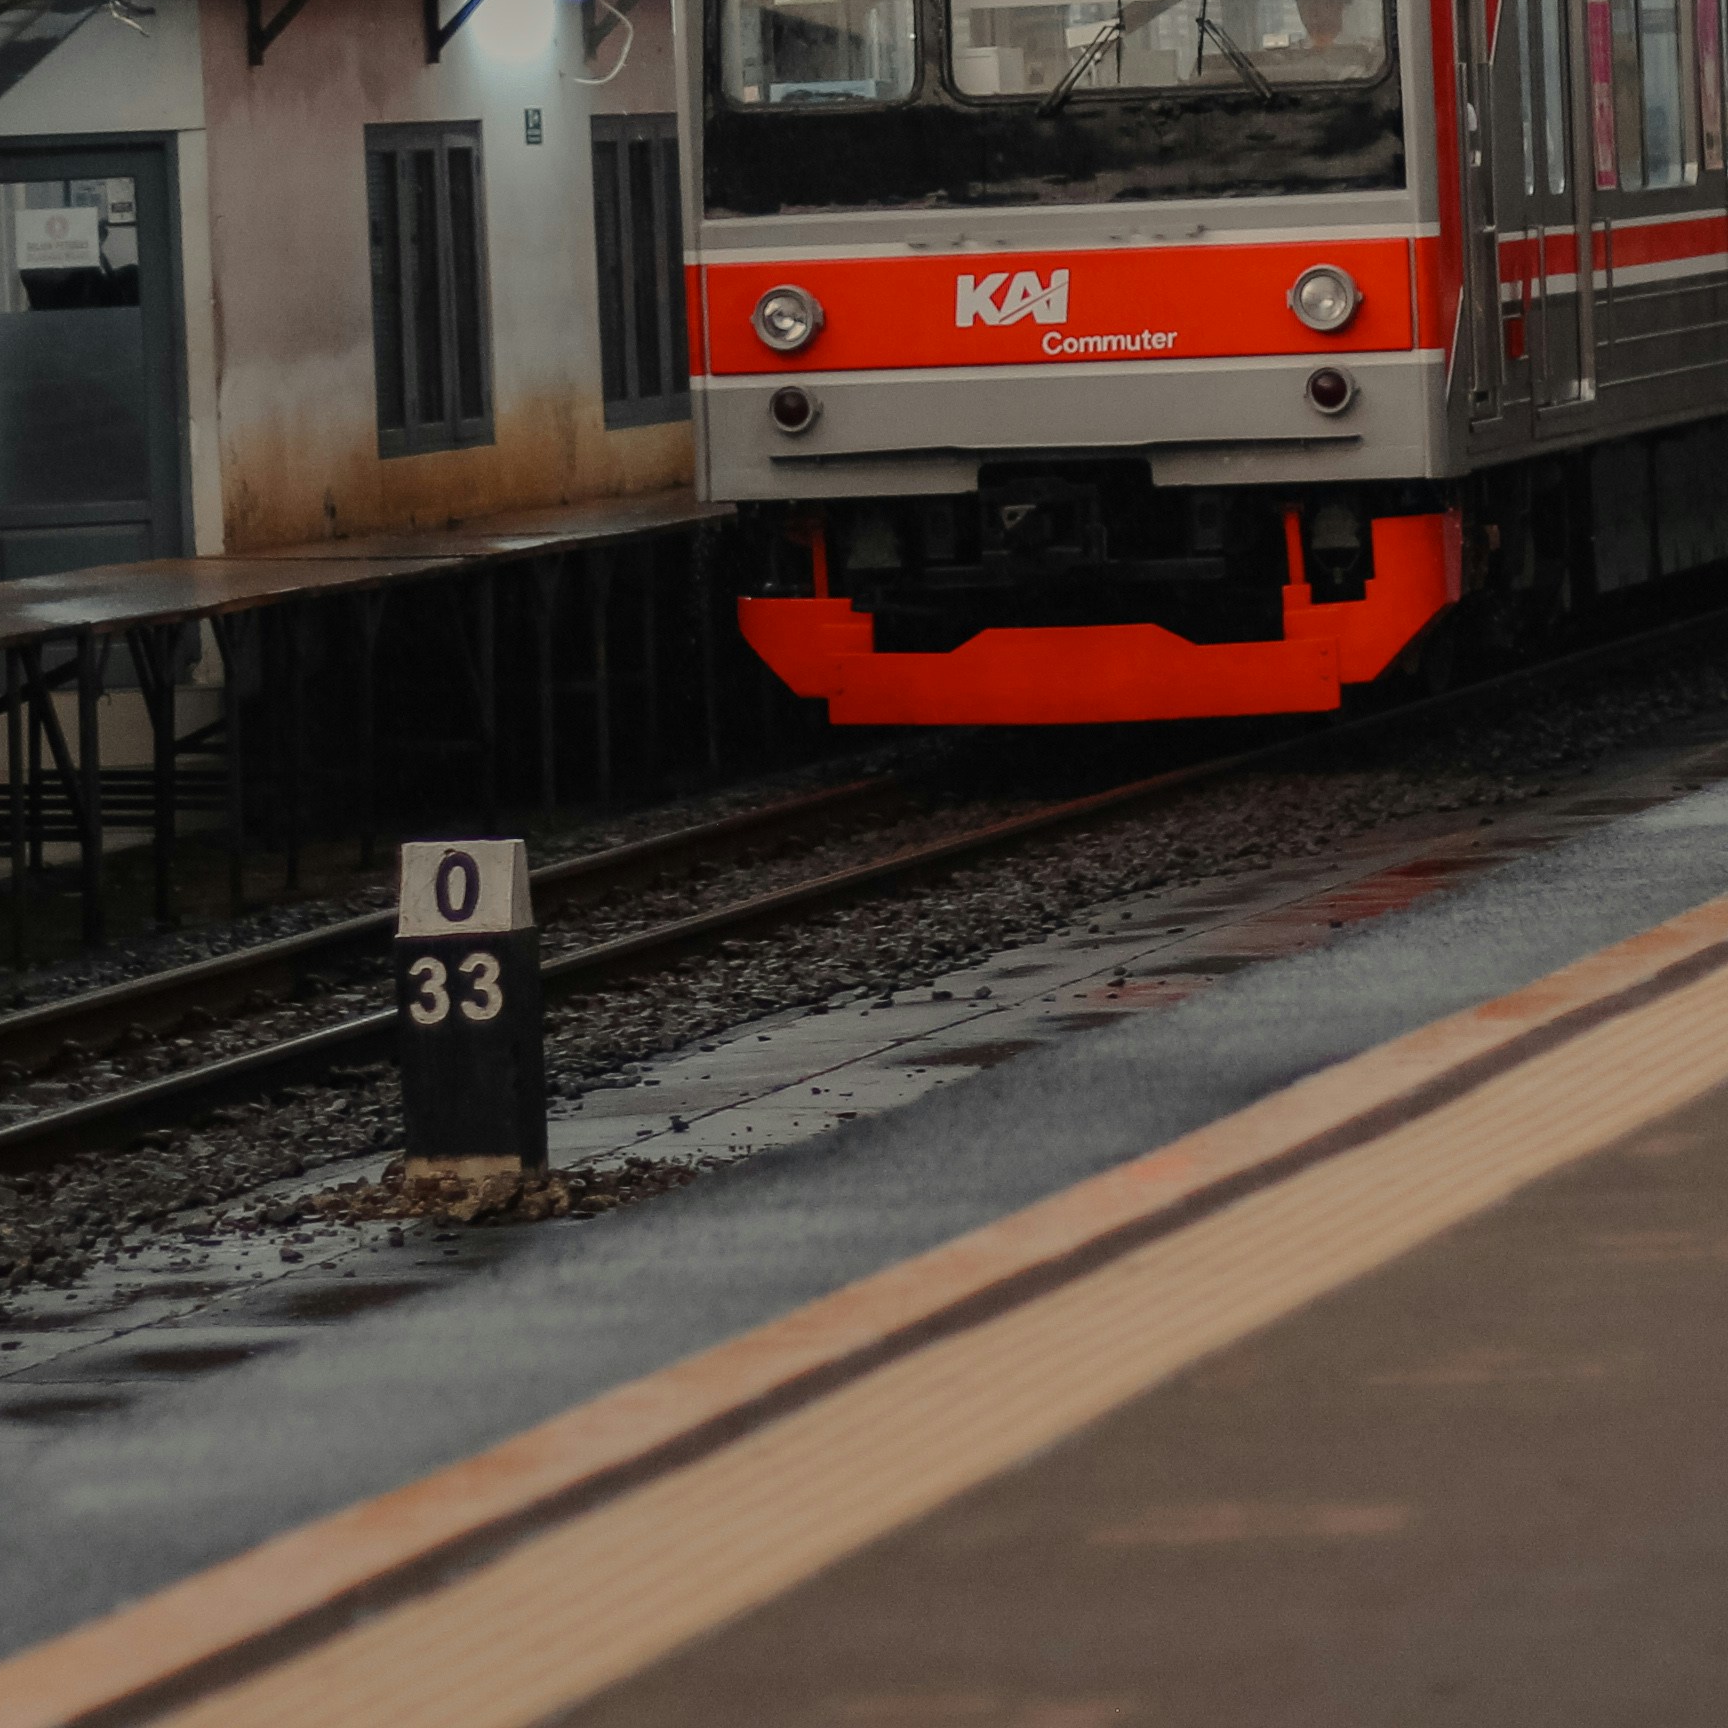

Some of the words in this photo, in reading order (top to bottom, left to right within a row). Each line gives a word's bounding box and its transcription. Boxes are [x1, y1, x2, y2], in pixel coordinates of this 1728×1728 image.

[955, 268, 1070, 328] KAI
[1041, 329, 1178, 355] Commuter
[436, 850, 480, 923] 0
[409, 952, 503, 1025] 33
